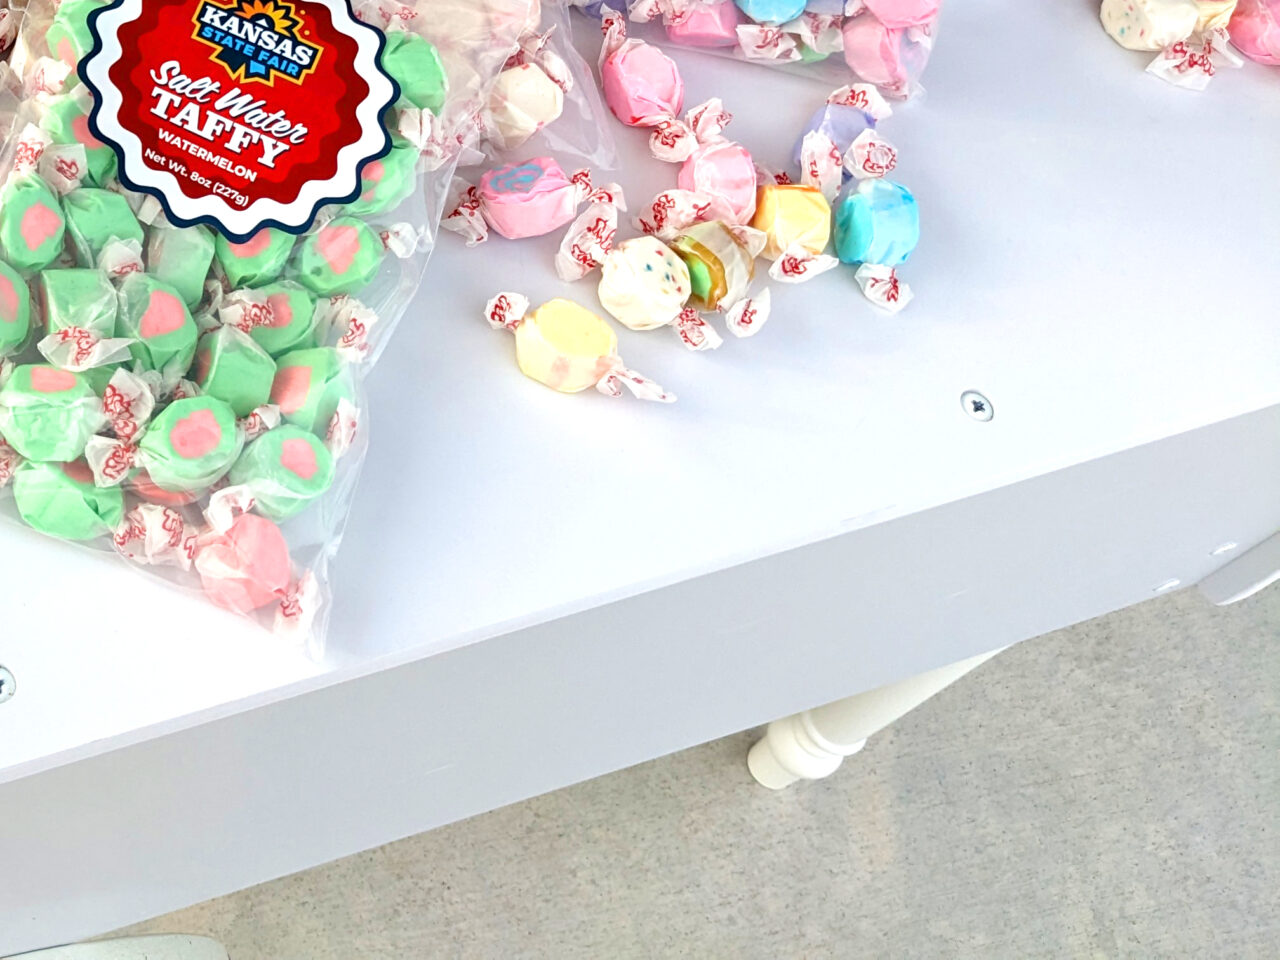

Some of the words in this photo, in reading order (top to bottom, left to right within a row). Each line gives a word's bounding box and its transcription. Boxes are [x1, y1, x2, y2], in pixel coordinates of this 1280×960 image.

[200, 5, 313, 66] KANSAS
[201, 26, 255, 57] STATE
[257, 50, 299, 76] FAIR
[149, 60, 220, 104] Salt
[214, 86, 308, 145] Water
[149, 86, 290, 169] TAFFY
[144, 148, 166, 166] Net
[168, 159, 188, 177] Wt.
[190, 171, 212, 189] 8oz
[212, 182, 249, 207] (227g)
[157, 128, 258, 183] WATERMELON
